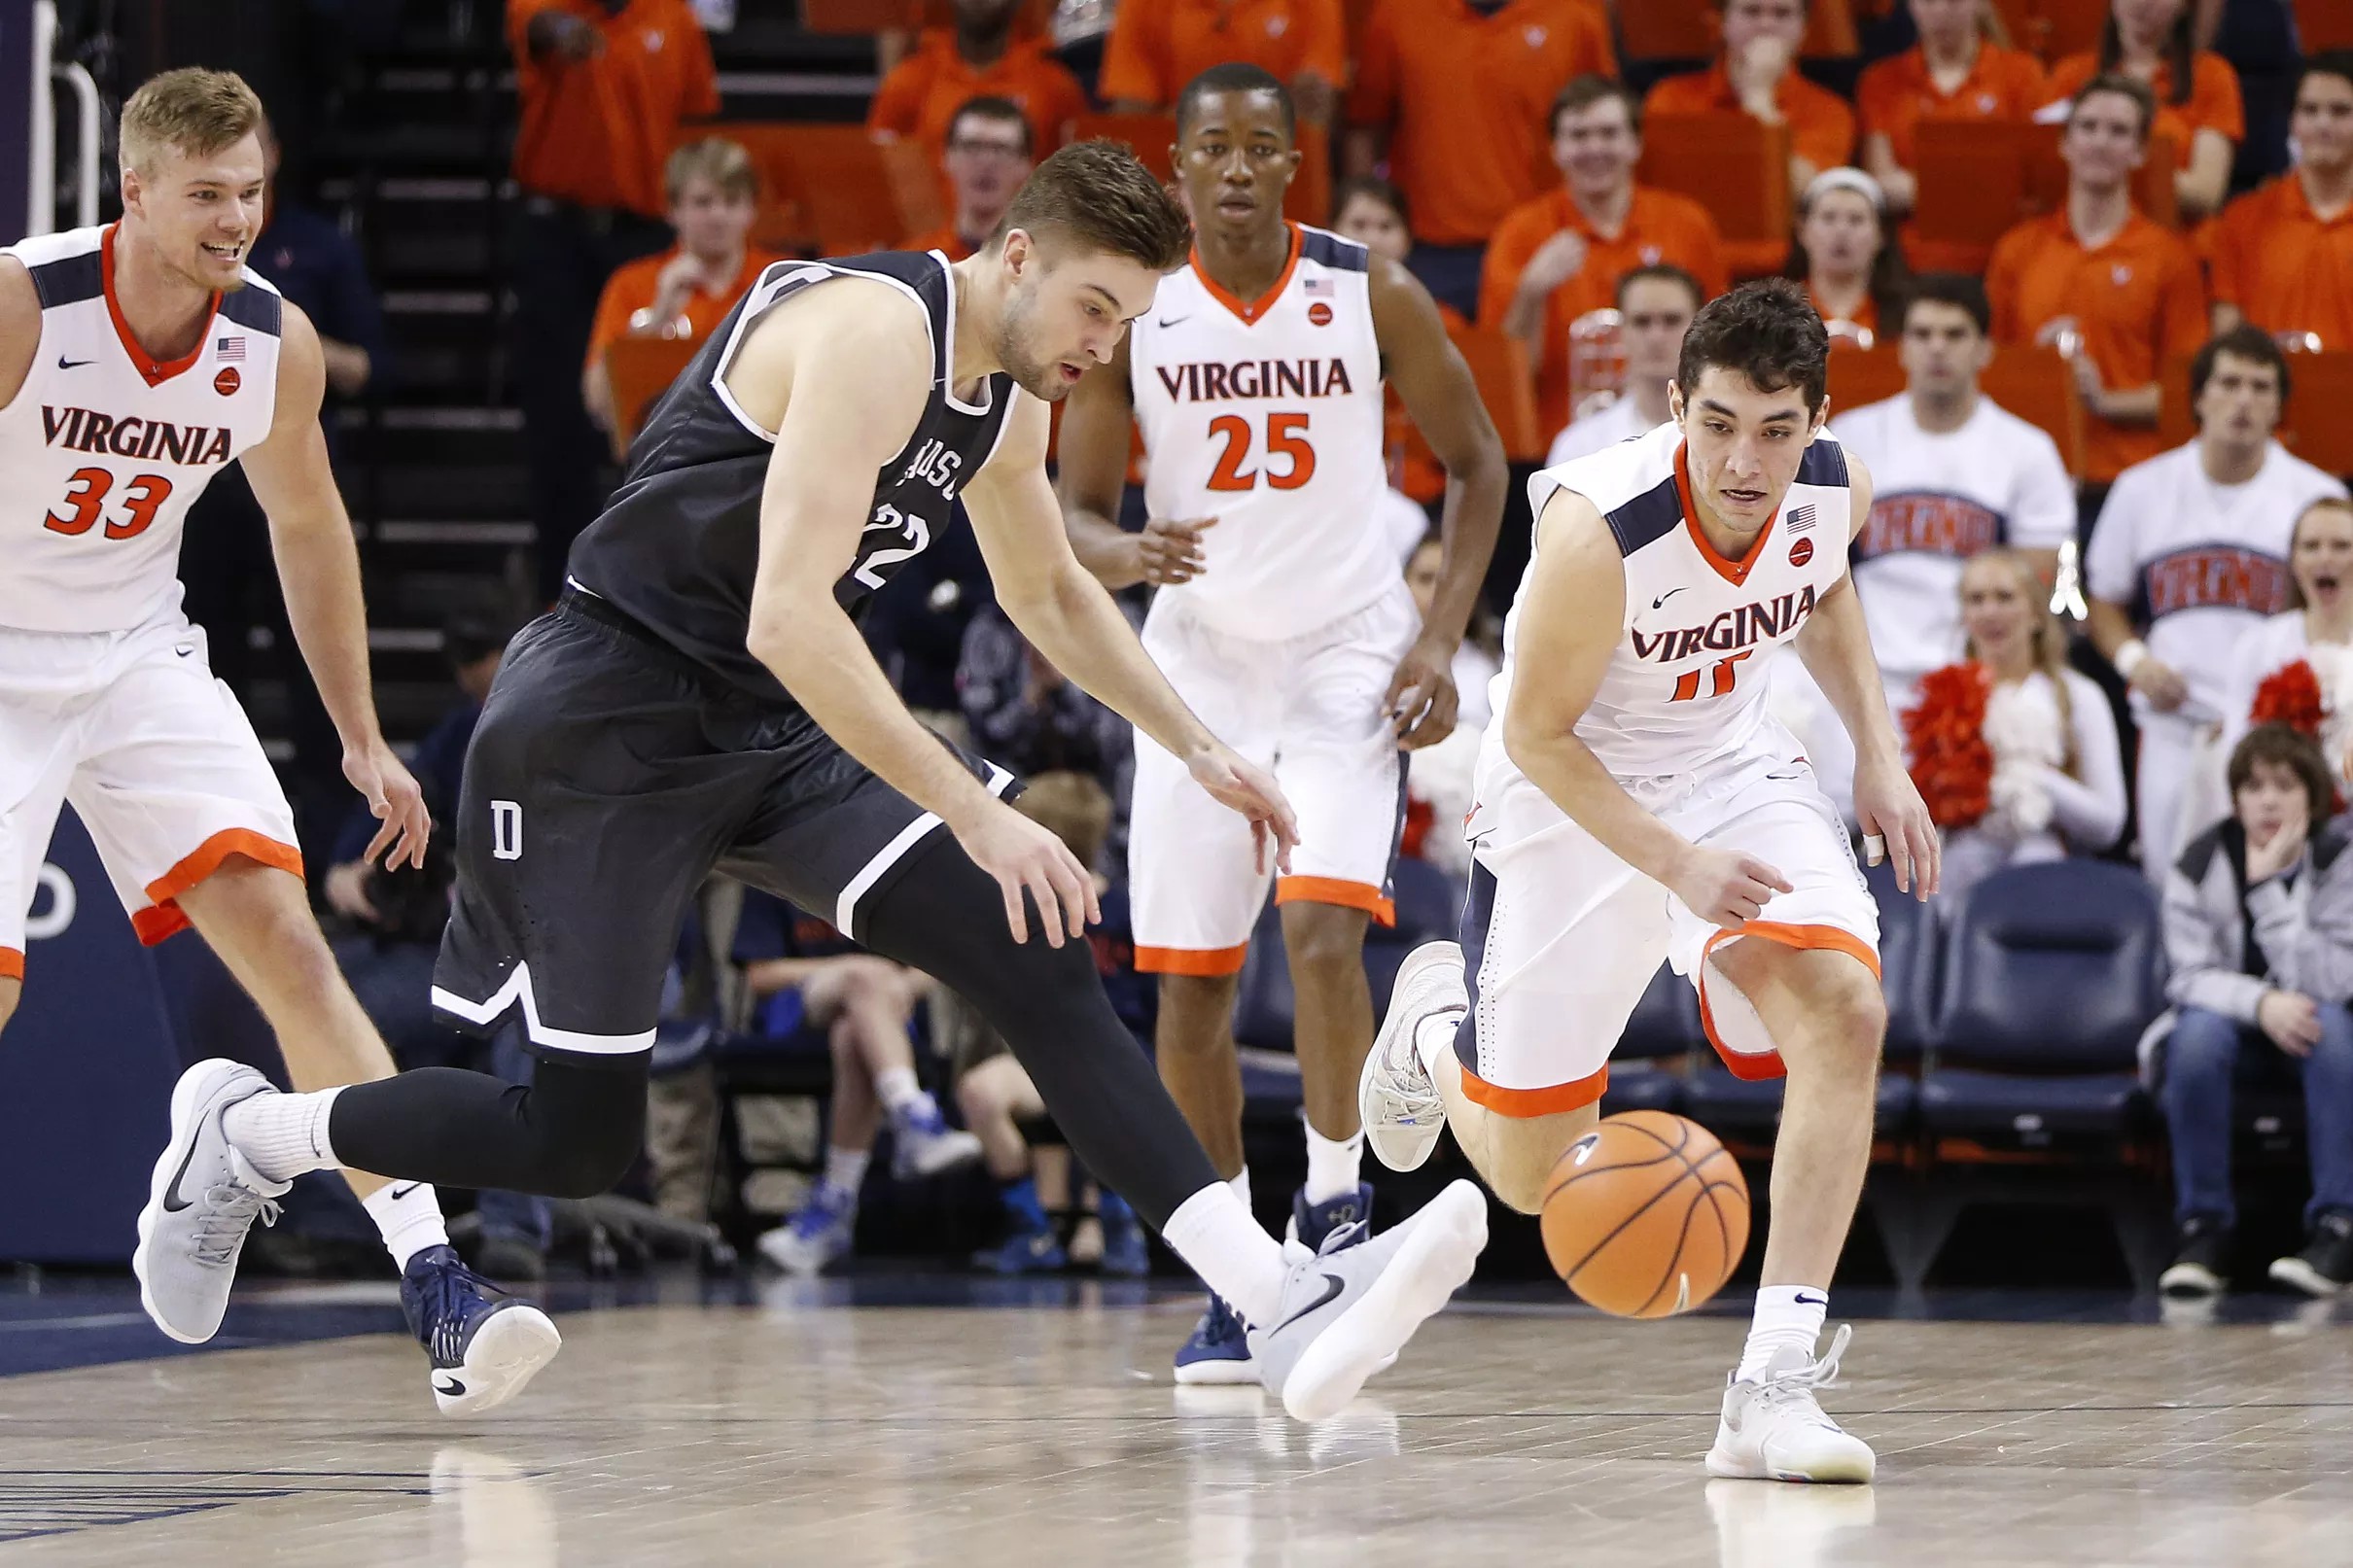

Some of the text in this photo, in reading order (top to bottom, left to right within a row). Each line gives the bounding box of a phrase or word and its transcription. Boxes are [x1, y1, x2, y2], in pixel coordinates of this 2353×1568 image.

[1156, 358, 1352, 404] VIRGINIA
[41, 404, 232, 466] VIRGINIA
[1206, 412, 1317, 491] 25
[43, 467, 173, 540] 33
[1632, 582, 1816, 663] VIRGINIA
[490, 800, 523, 860] D
